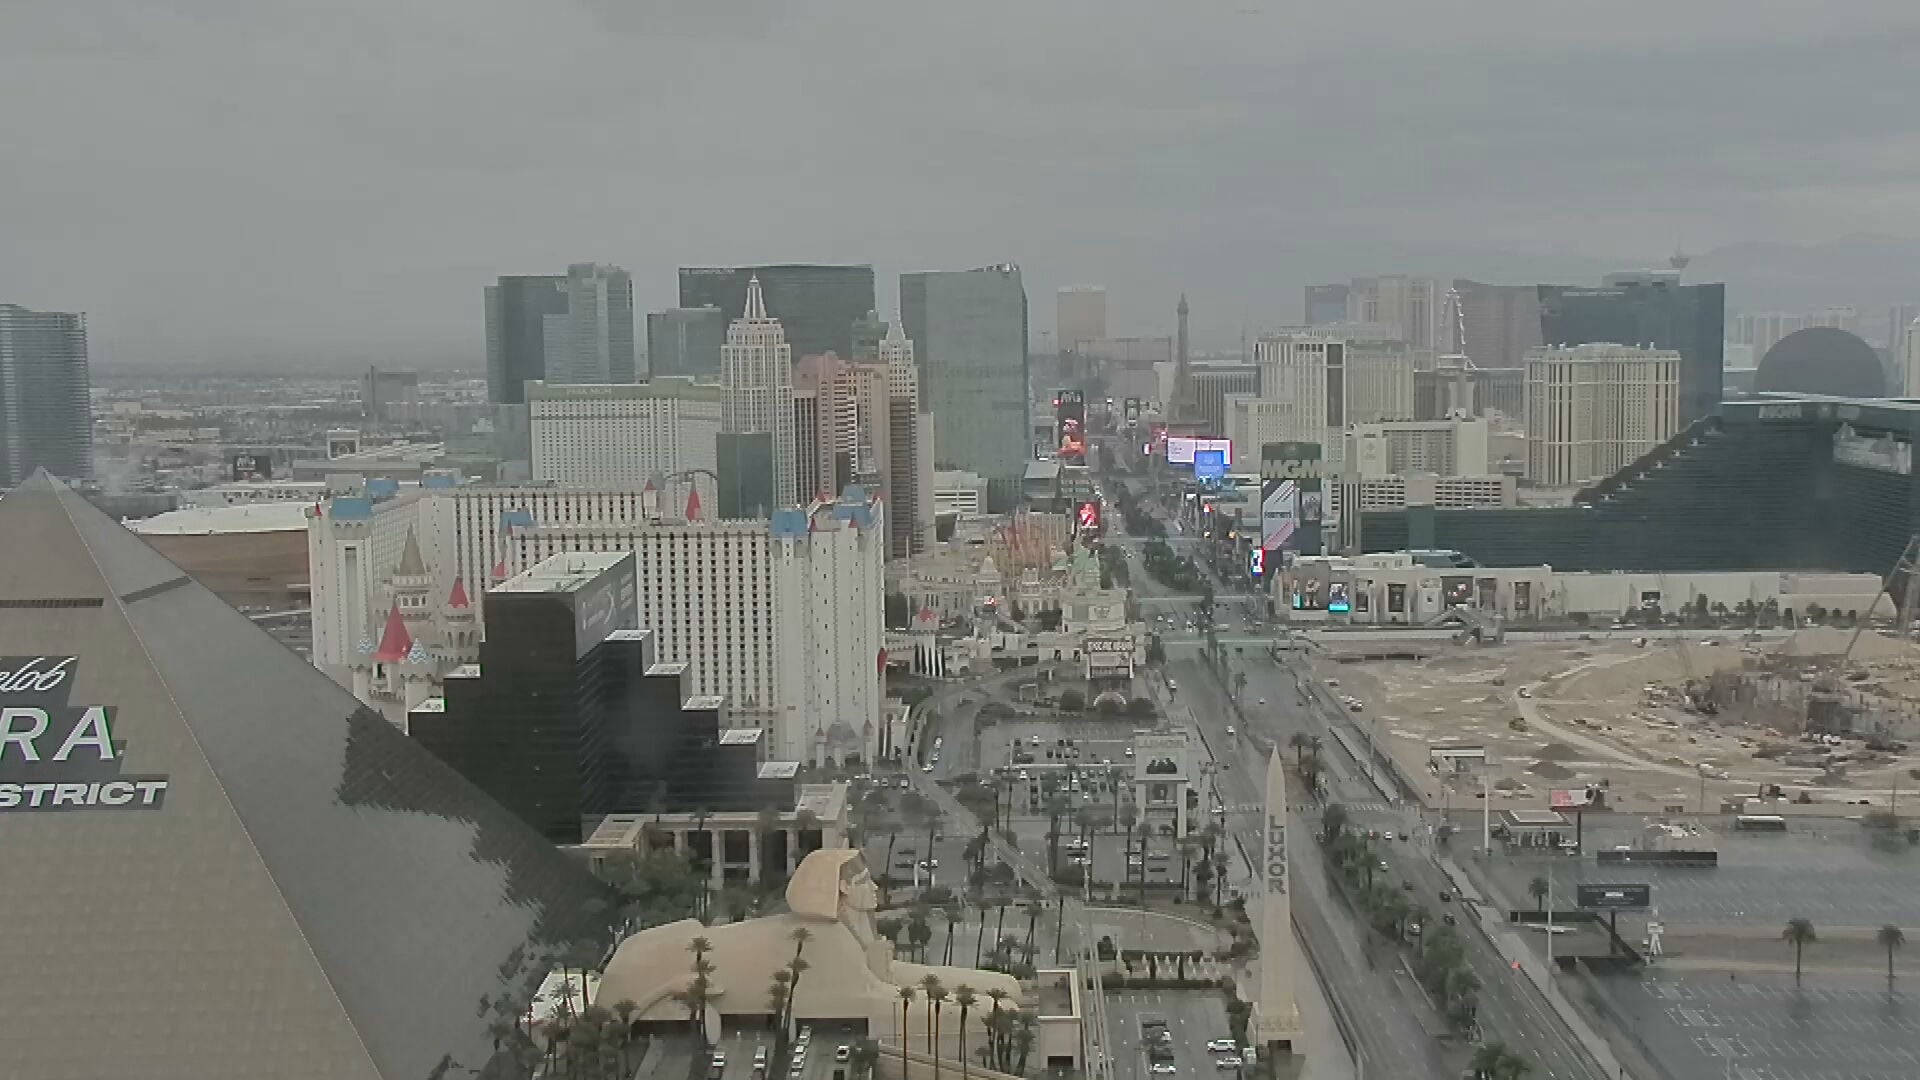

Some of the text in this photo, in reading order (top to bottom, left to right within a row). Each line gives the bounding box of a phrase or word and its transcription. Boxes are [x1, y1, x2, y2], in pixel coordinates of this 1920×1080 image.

[1261, 459, 1321, 478] MGM
[0, 707, 115, 761] RA
[0, 781, 168, 807] STRICT
[1268, 815, 1286, 895] LUXOR
